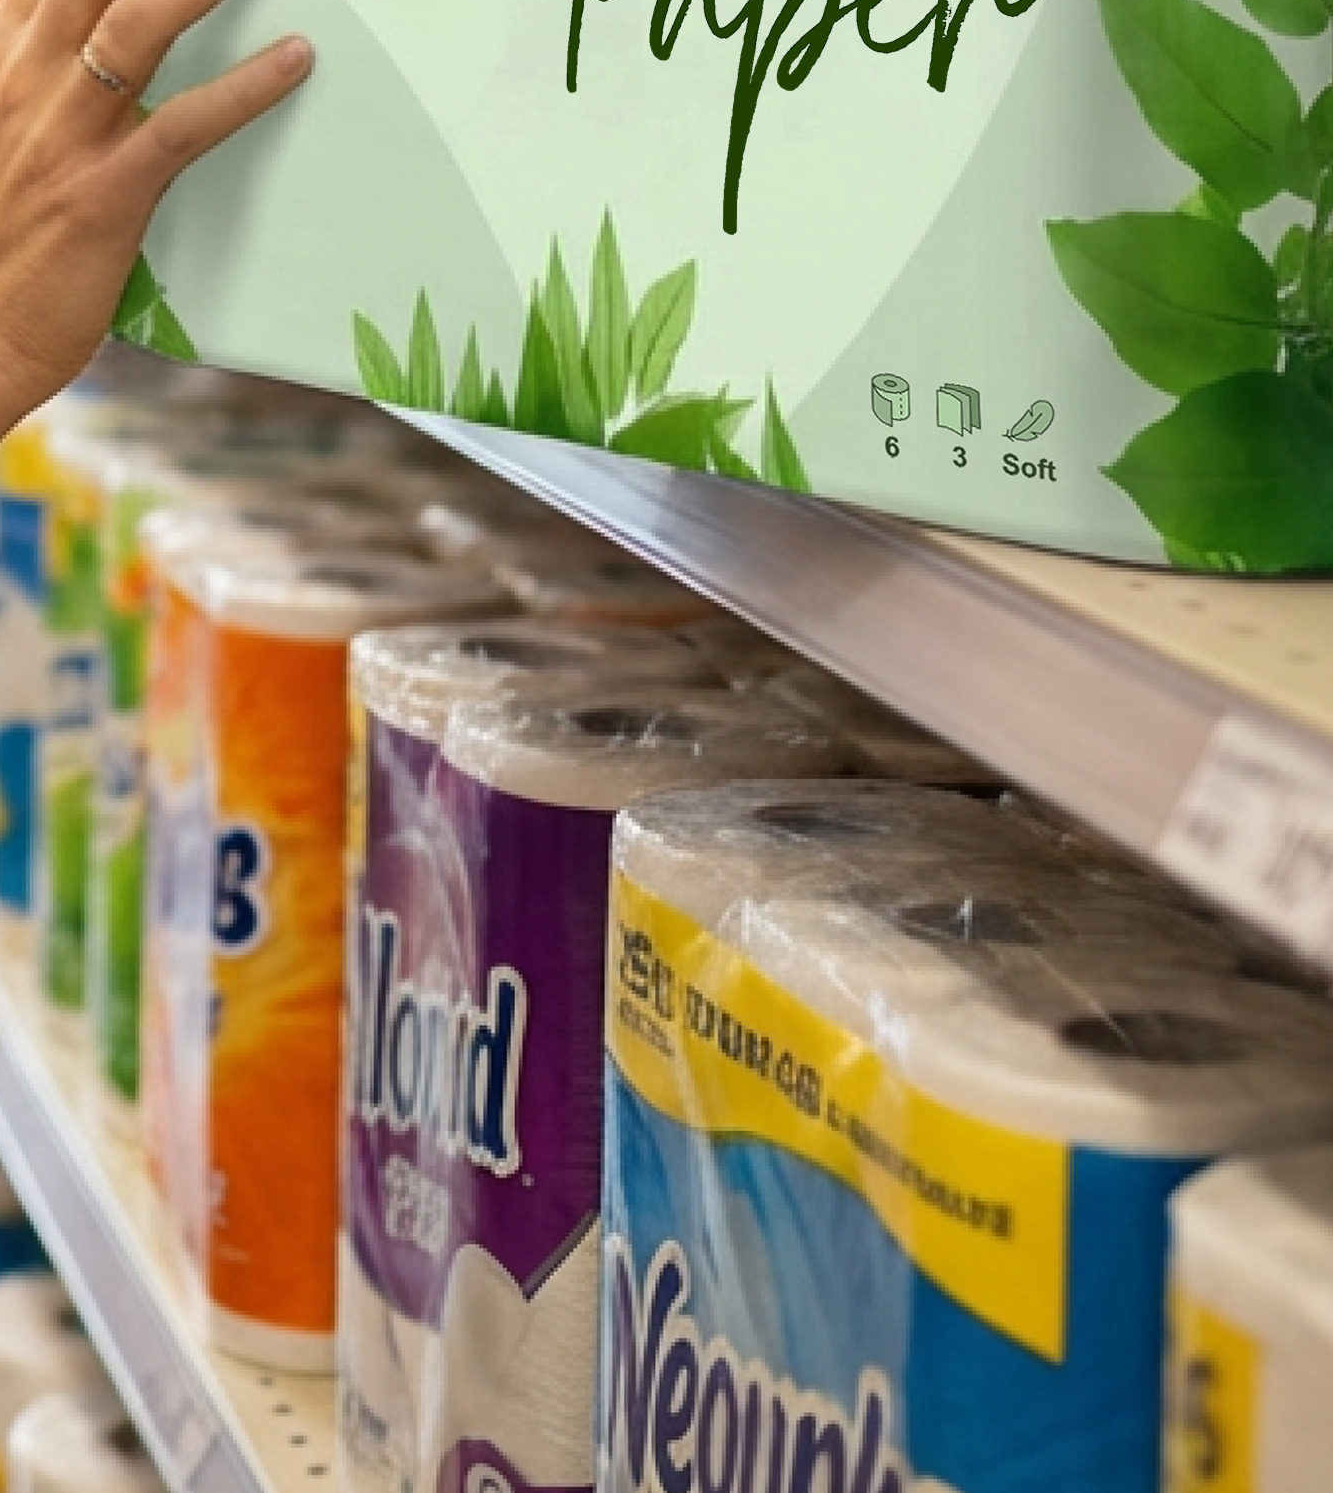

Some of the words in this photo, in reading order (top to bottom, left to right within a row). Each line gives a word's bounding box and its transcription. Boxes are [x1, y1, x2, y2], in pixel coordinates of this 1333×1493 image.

[884, 435, 901, 459] 6
[952, 445, 968, 468] 3
[1001, 452, 1059, 483] Soft
